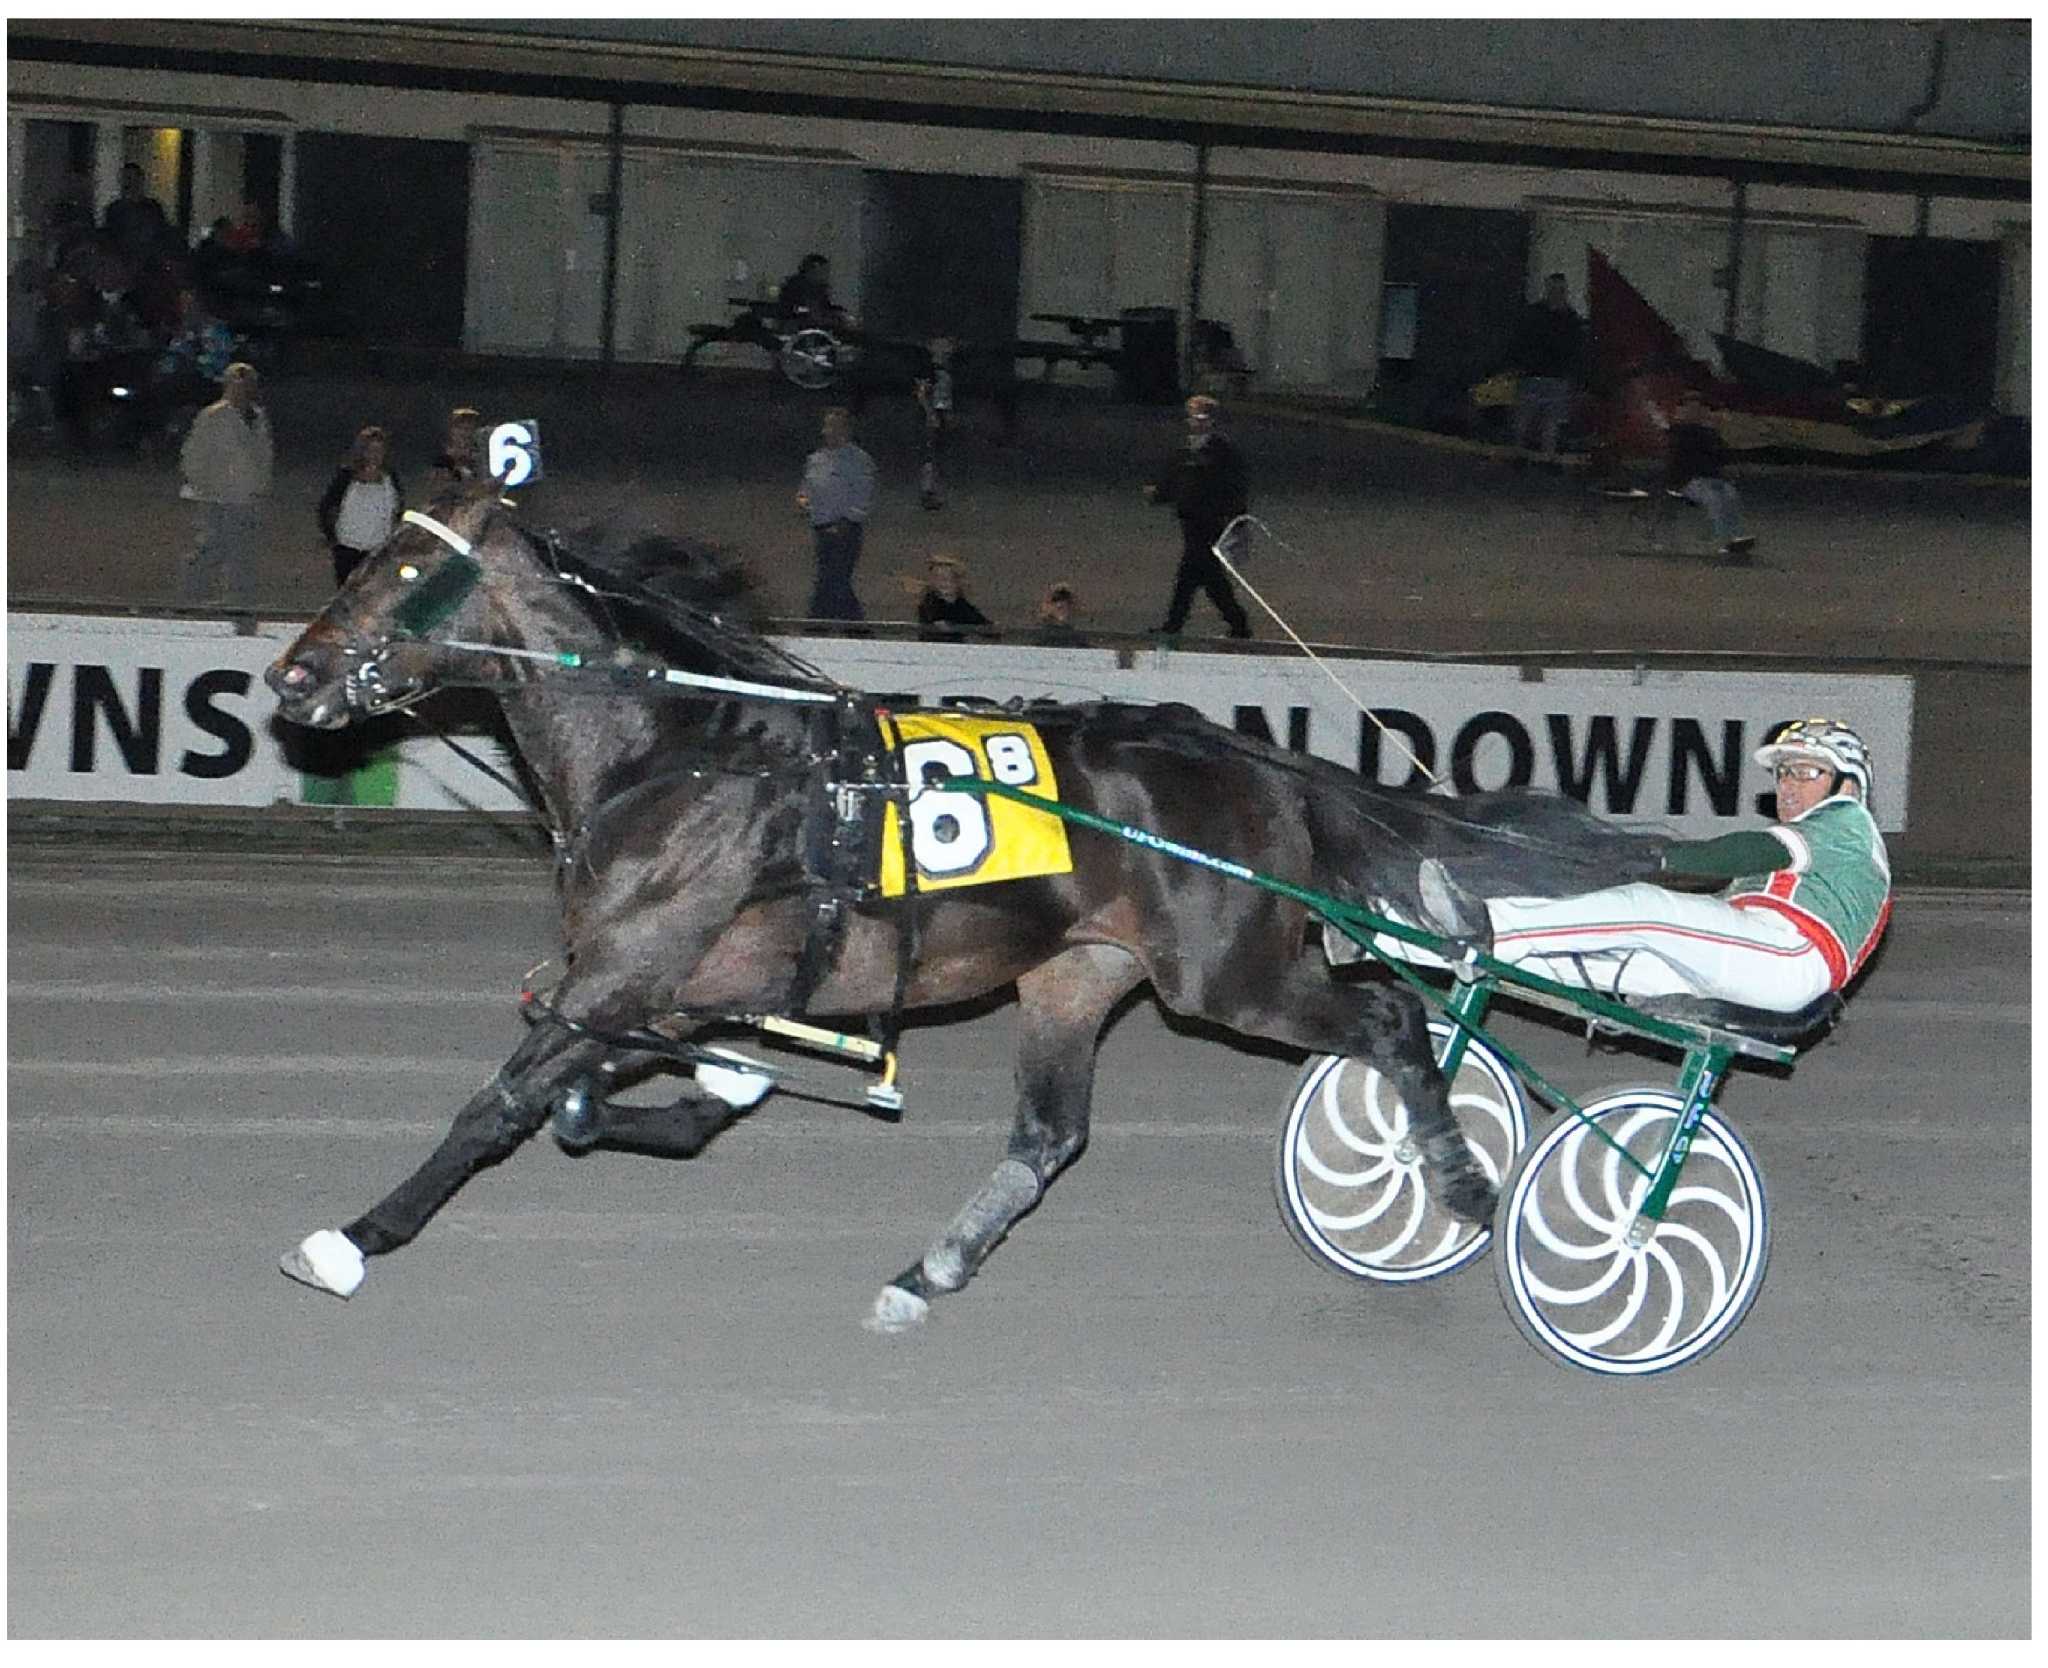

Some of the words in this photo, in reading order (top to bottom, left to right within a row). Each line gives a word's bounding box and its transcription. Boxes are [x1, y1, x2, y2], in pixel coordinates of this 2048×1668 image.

[488, 423, 532, 486] 6
[983, 733, 1038, 787] 8
[902, 738, 993, 876] 6
